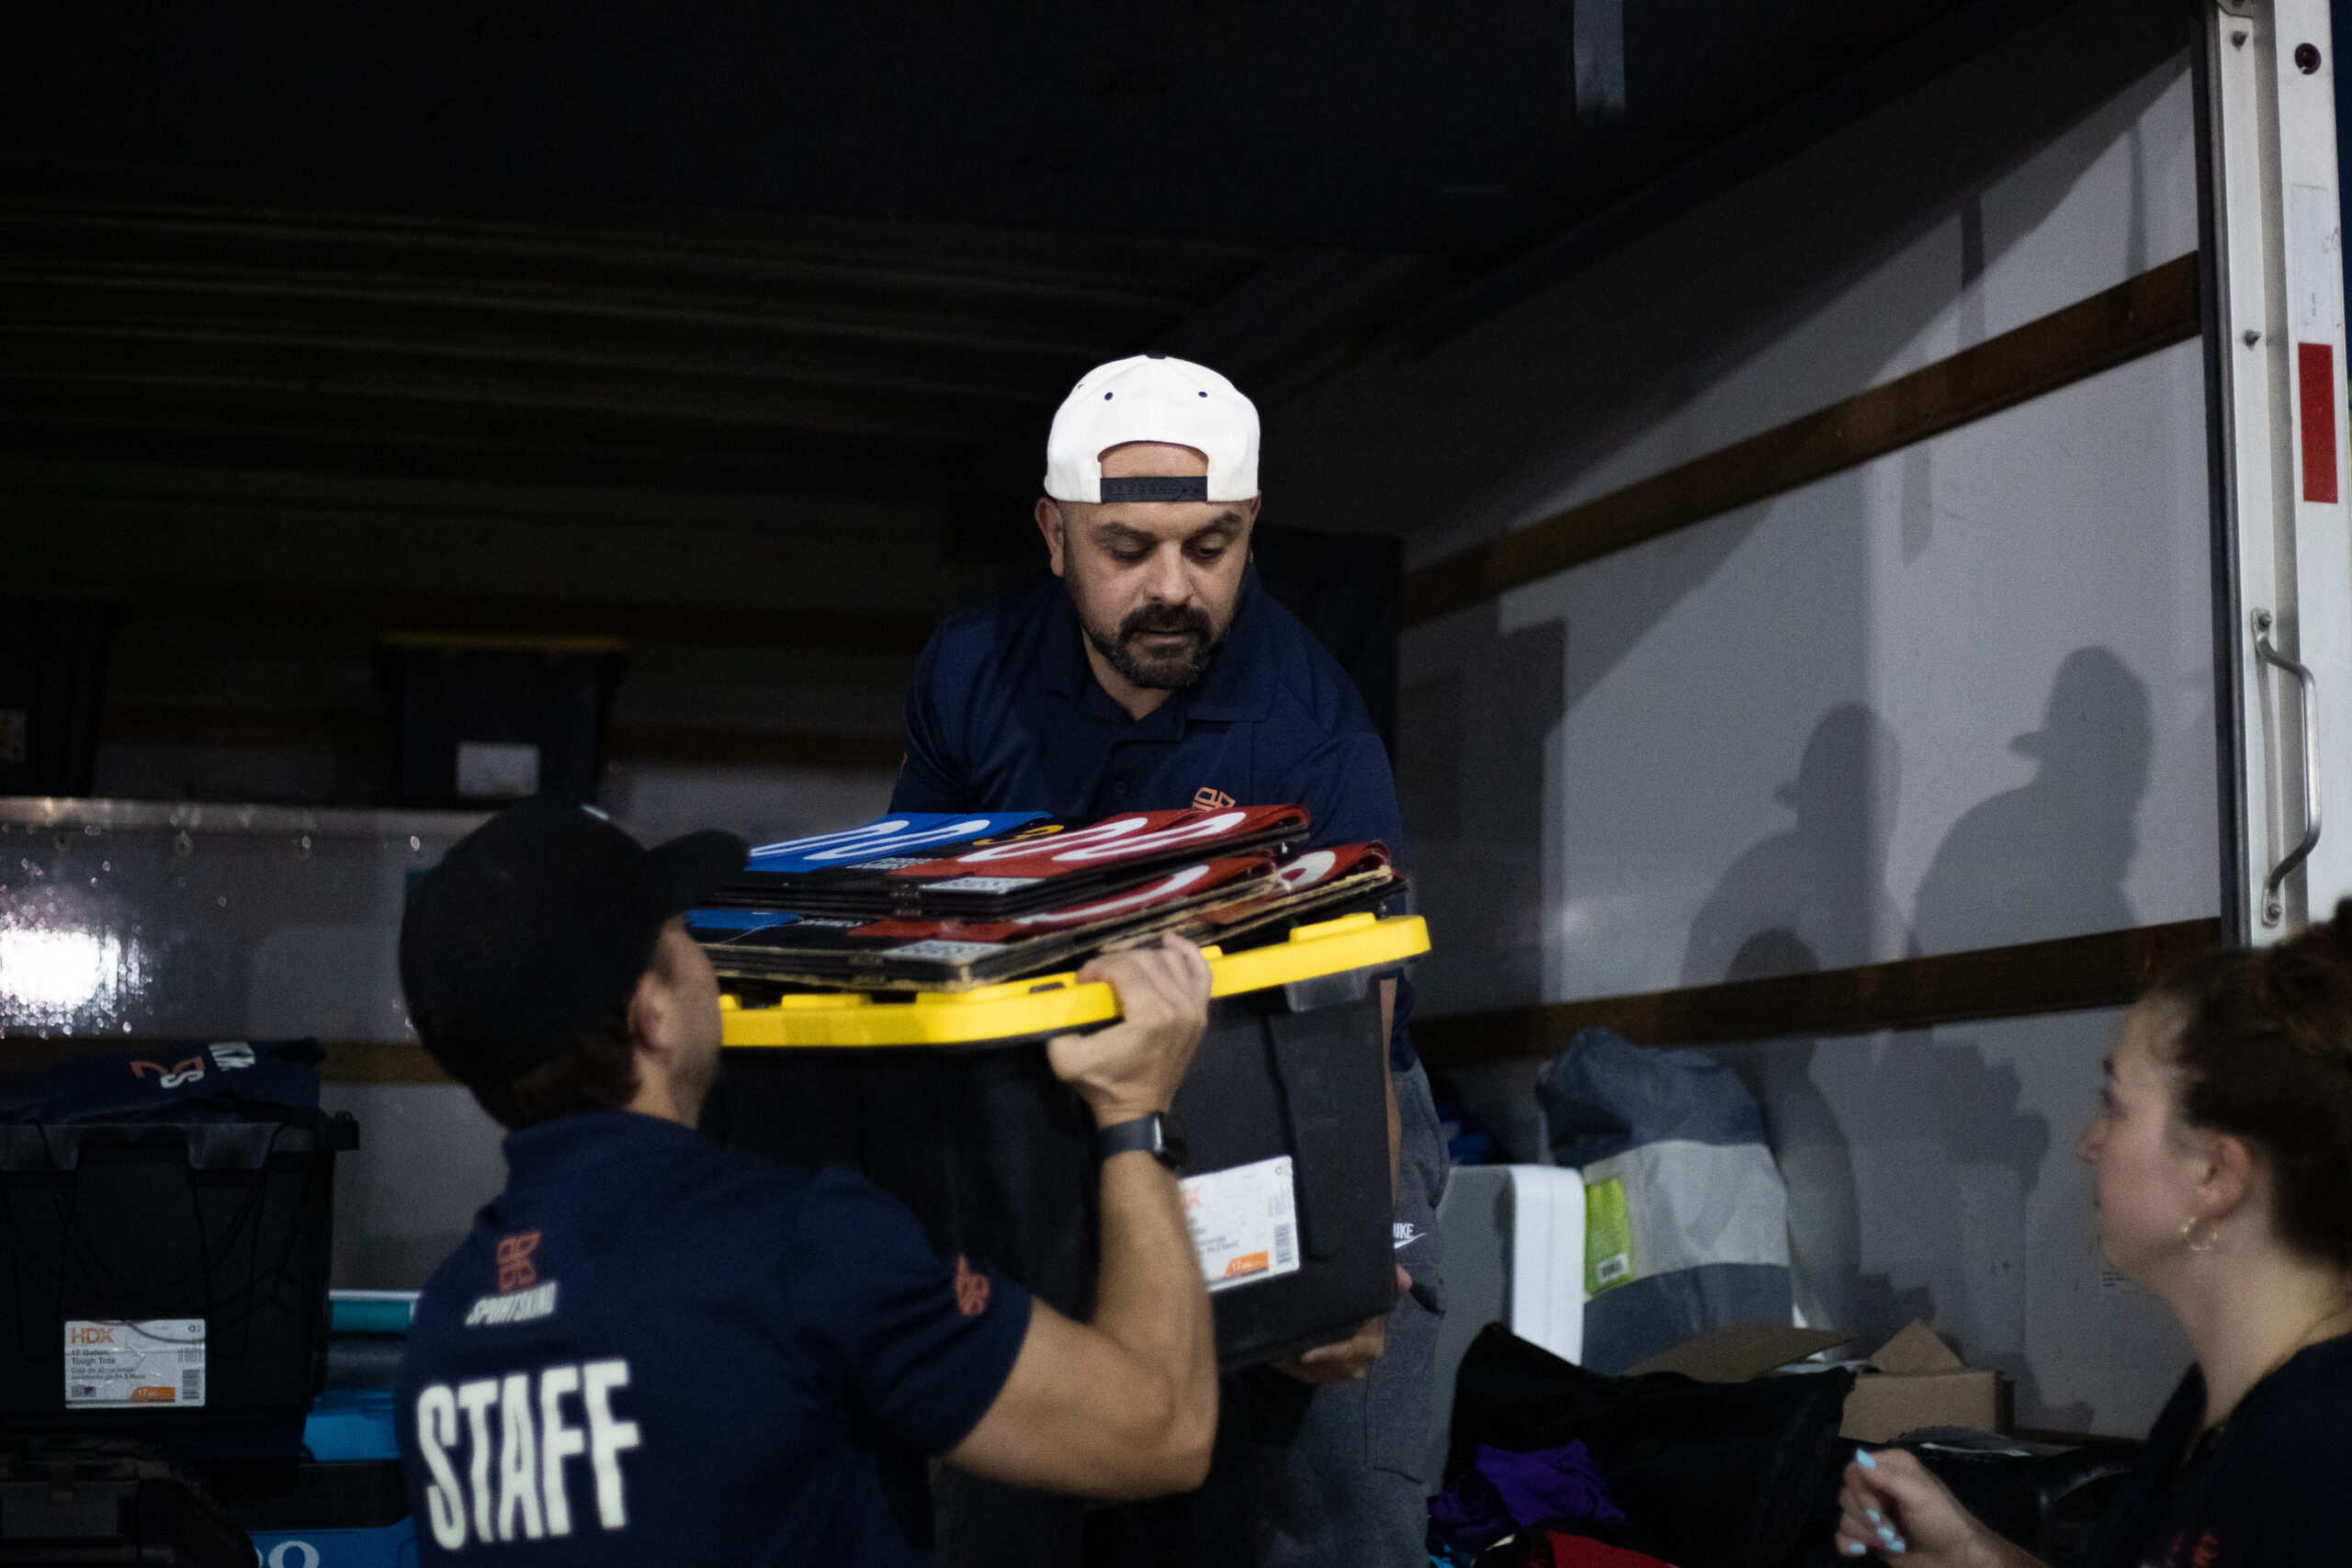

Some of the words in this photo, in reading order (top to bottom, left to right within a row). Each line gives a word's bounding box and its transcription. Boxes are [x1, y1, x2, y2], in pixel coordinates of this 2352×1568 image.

[71, 1327, 114, 1345] HDX
[72, 1358, 96, 1366] Tough
[417, 1359, 640, 1551] STAFF
